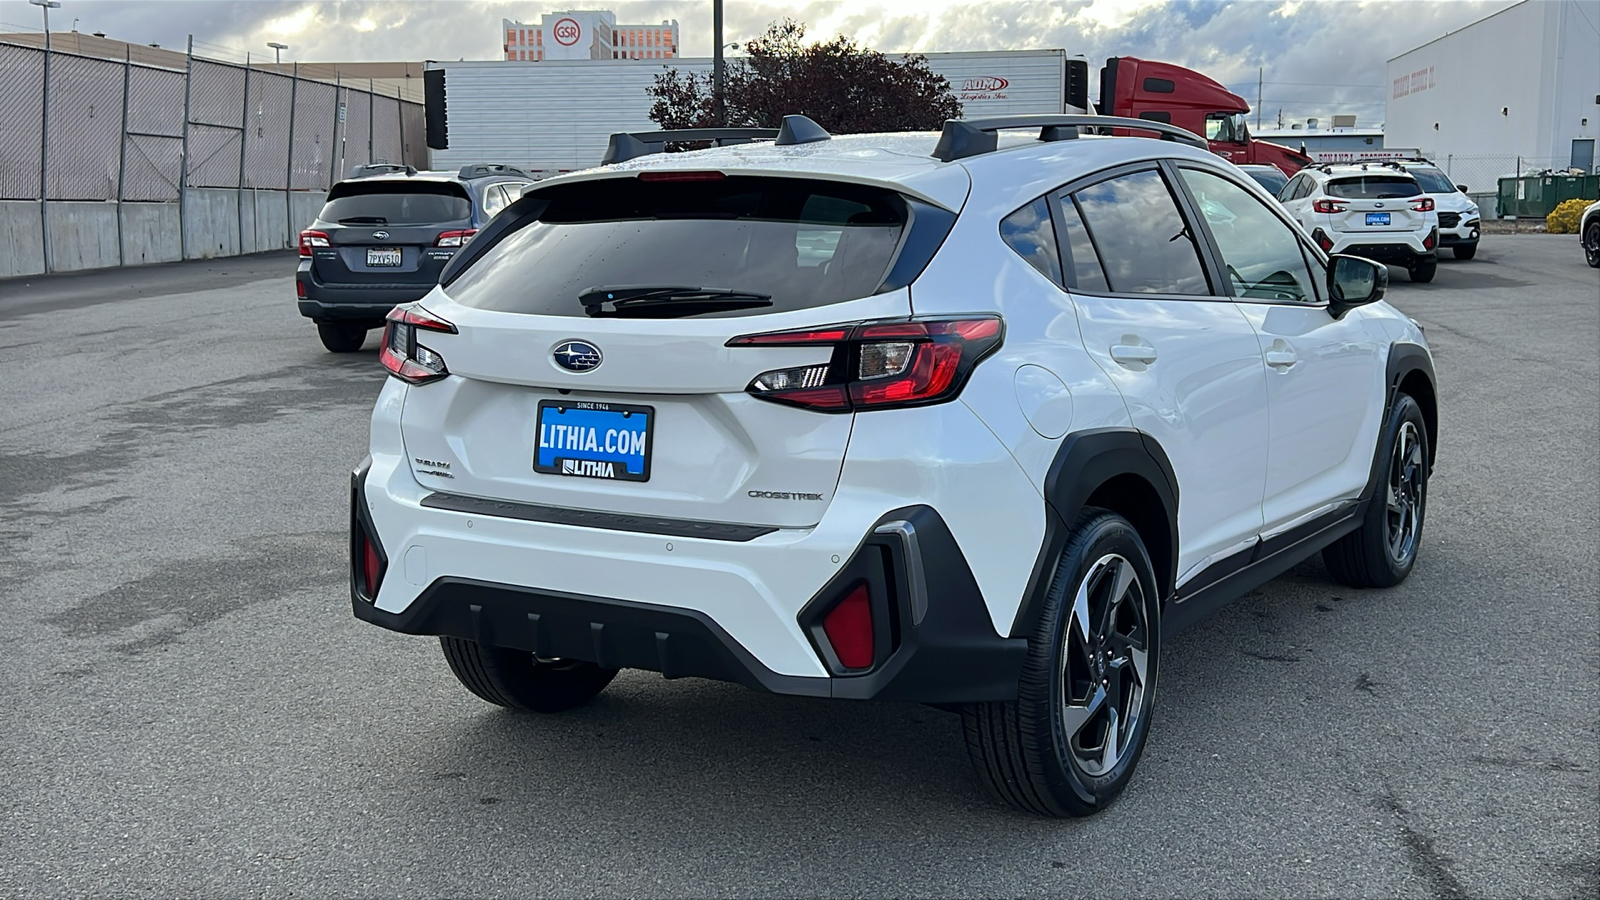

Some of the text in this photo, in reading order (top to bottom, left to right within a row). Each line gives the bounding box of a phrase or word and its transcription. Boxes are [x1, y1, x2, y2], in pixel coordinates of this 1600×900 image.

[557, 26, 577, 39] GSR
[962, 78, 996, 91] ADM
[368, 254, 400, 263] 7PXV510
[577, 402, 610, 411] SINCE 1946
[539, 423, 647, 456] LITHIA.COM
[574, 459, 615, 478] LITHIA
[747, 490, 825, 502] CROSSTREK
